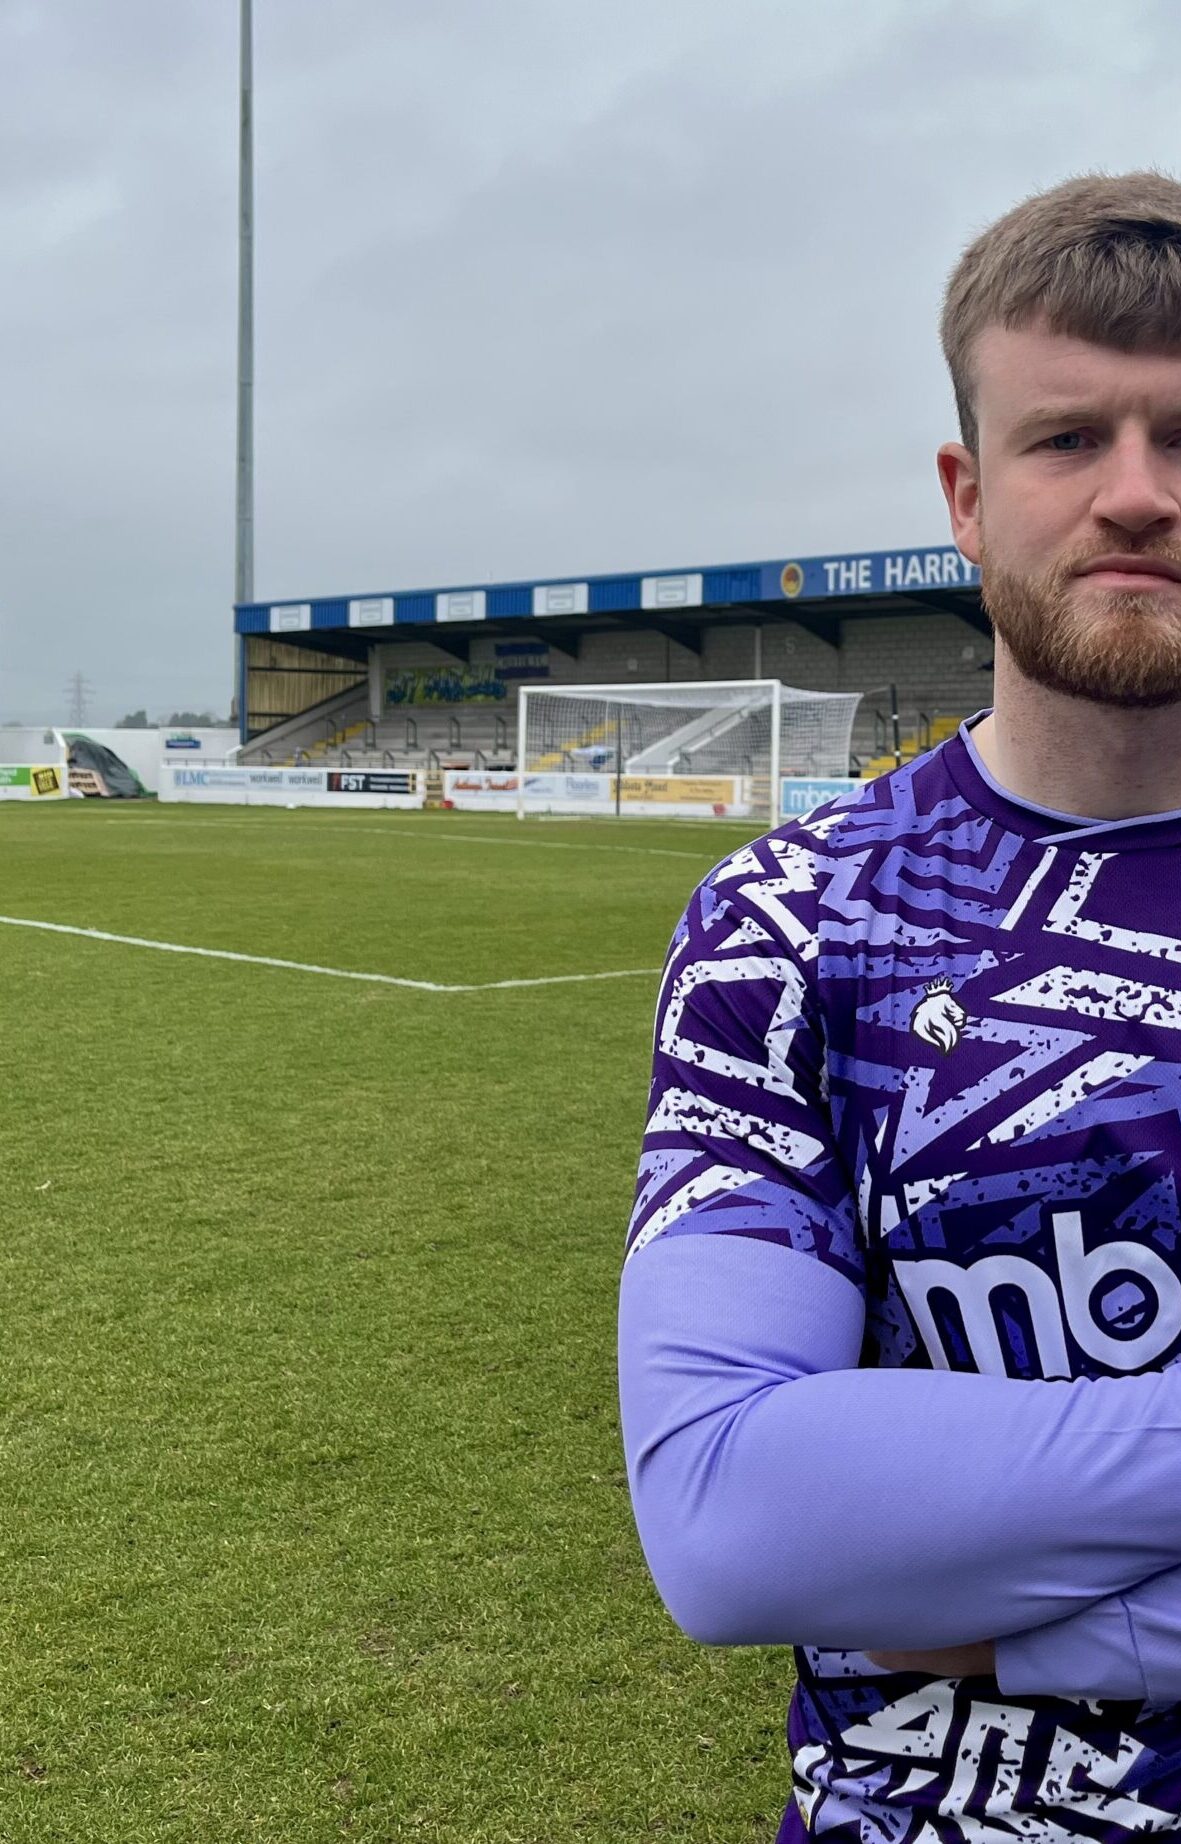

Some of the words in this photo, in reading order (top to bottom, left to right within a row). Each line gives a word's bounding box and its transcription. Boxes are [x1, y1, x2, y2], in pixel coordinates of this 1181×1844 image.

[823, 559, 872, 591] THE
[884, 552, 974, 587] HARRY
[791, 784, 842, 809] mbn
